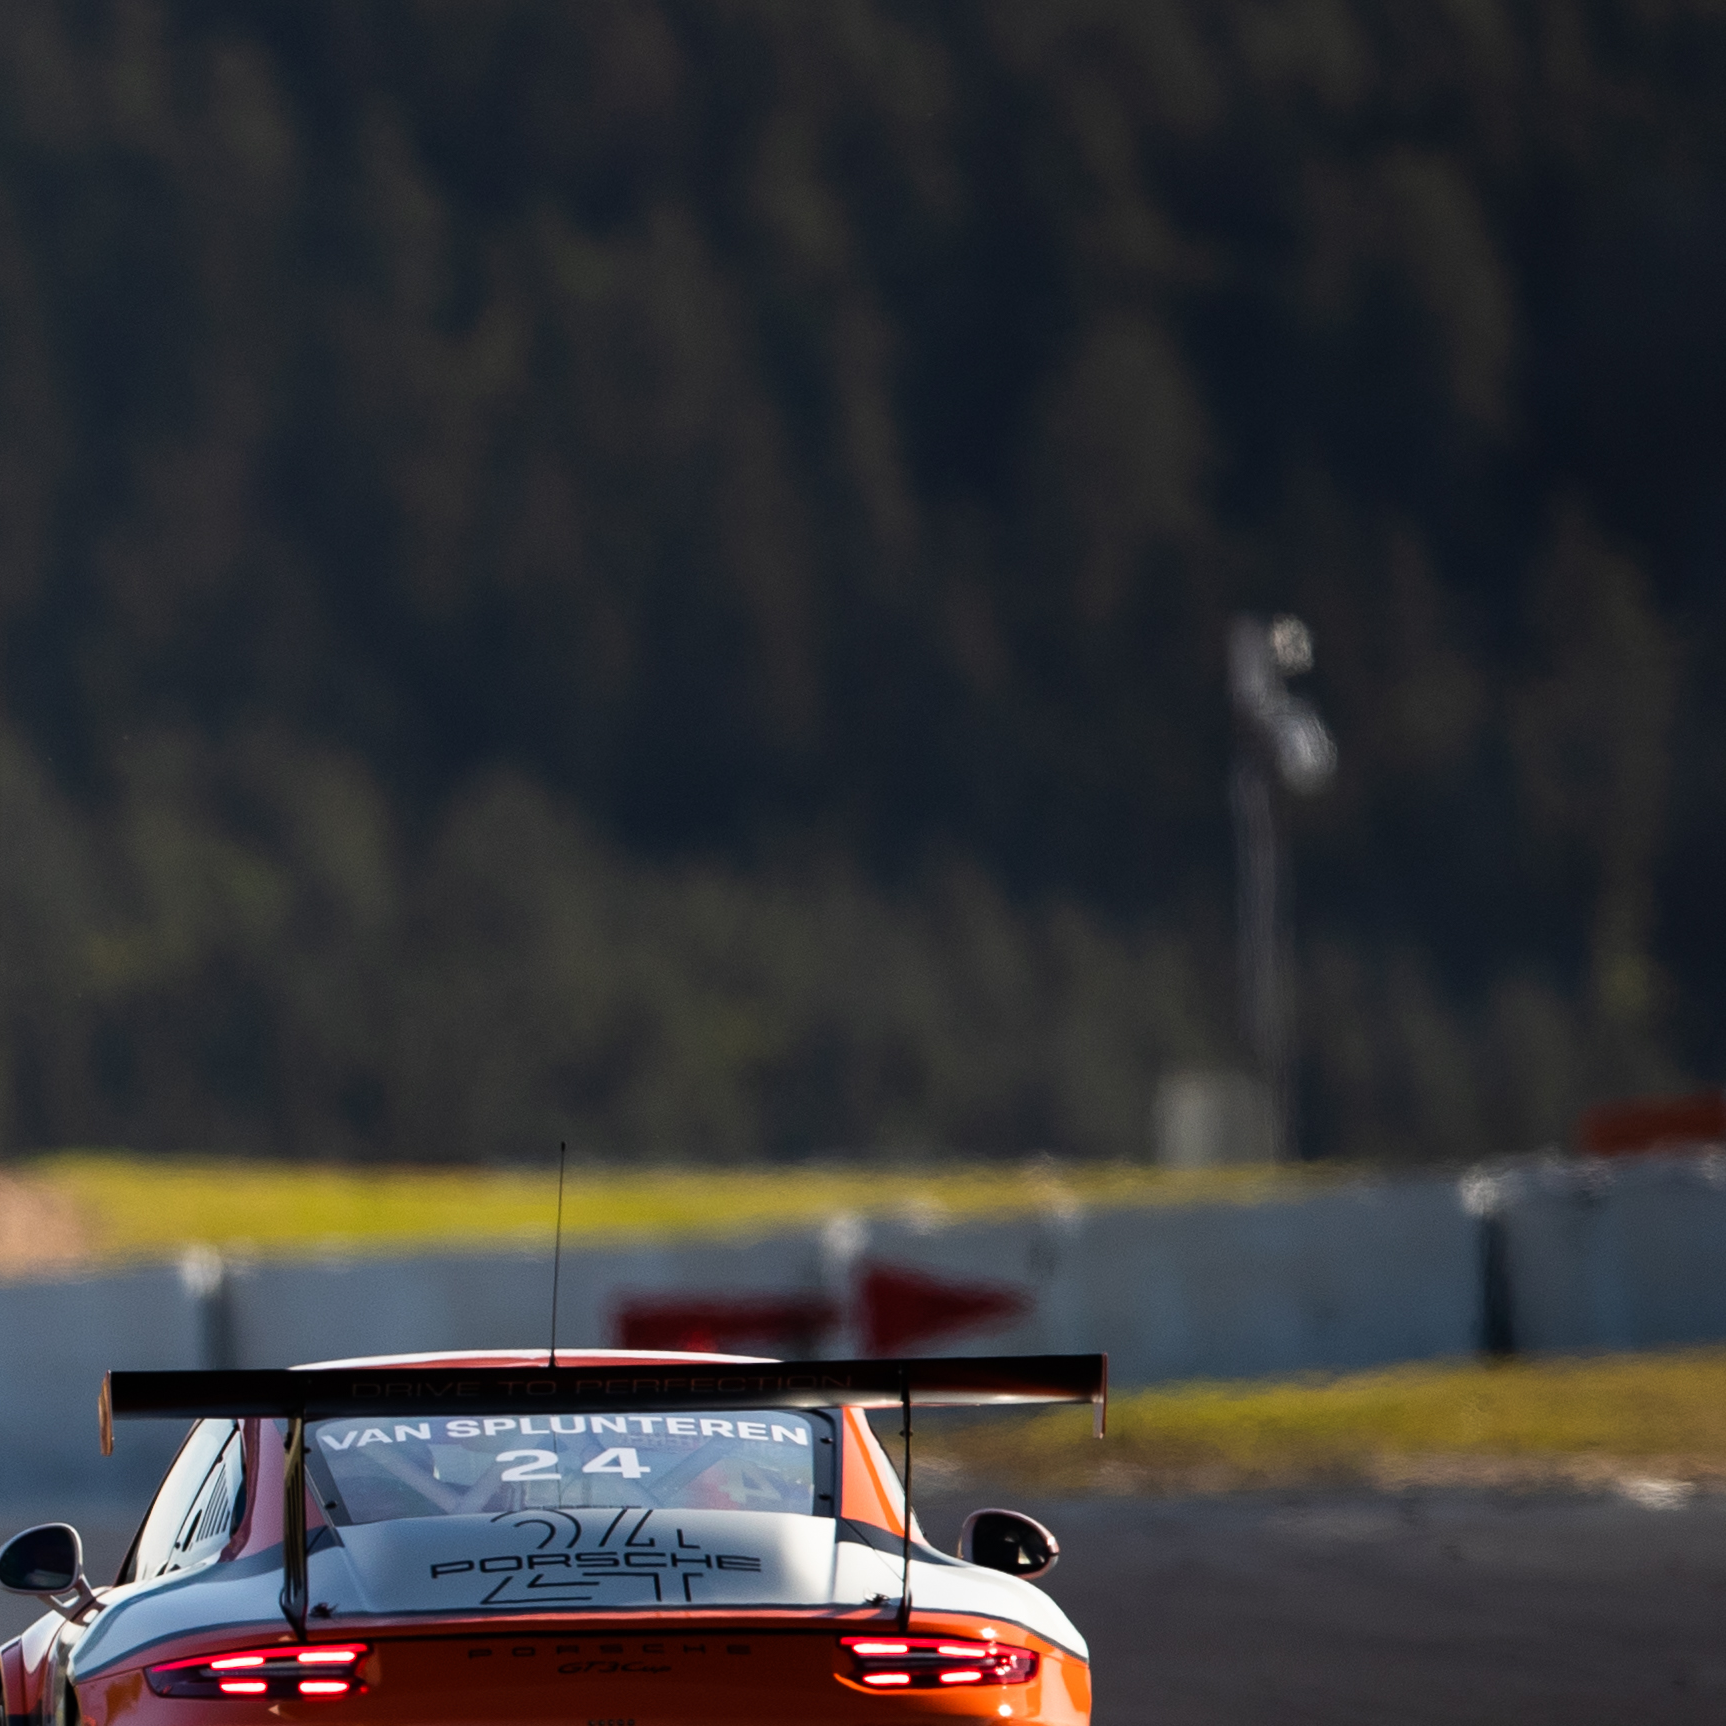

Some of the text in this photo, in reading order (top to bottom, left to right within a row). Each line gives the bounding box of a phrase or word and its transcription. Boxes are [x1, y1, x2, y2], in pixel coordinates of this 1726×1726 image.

[351, 1375, 853, 1399] DRIVE TO PERFECTION
[321, 1422, 432, 1451] VAN
[446, 1415, 809, 1446] SPLUNTEREN
[495, 1447, 651, 1482] 24
[430, 1551, 762, 1580] PORSCHE
[467, 1643, 752, 1659] PORSCHE
